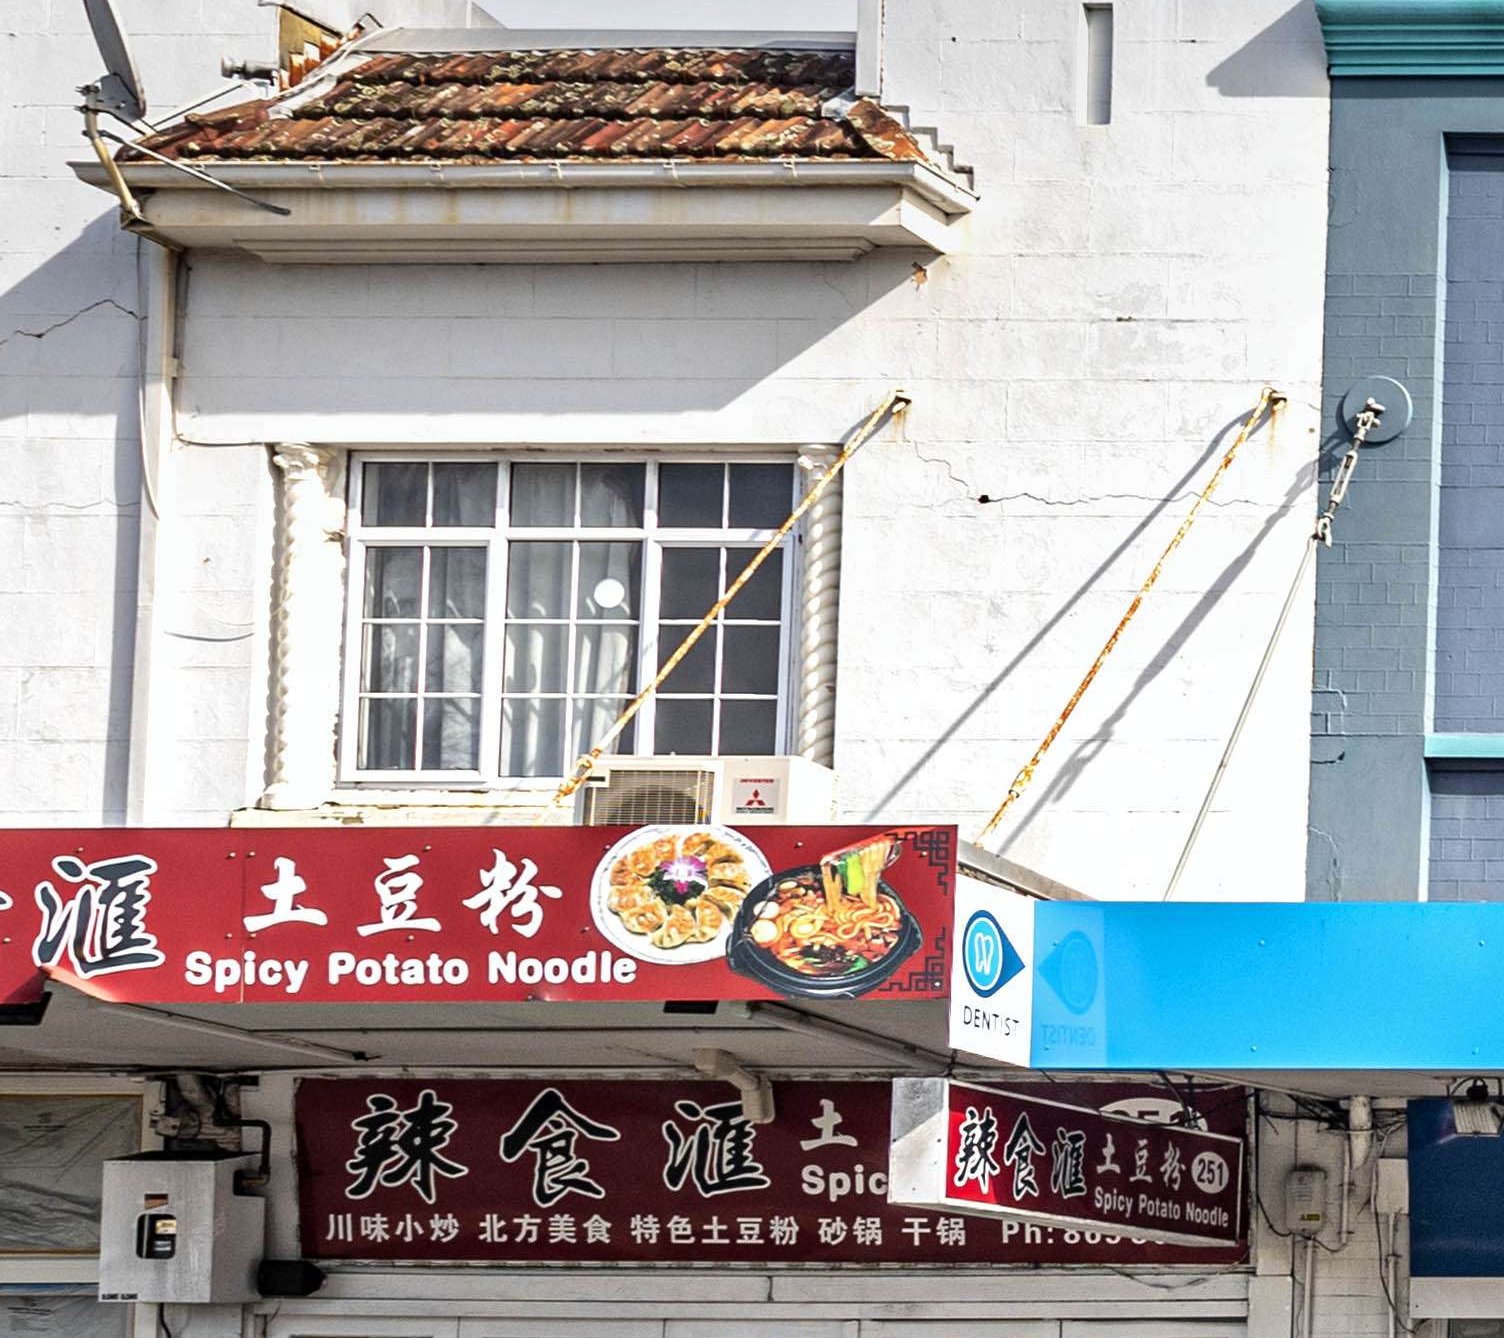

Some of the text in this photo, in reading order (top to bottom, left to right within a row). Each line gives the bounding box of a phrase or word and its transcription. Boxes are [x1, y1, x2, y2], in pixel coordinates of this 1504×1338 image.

[243, 848, 562, 938] 土豆粉
[185, 950, 637, 993] Spicy Potato Noodle
[801, 1163, 889, 1203] Spic
[1096, 1133, 1187, 1192] 土豆粉
[1196, 1158, 1224, 1187] 251
[1094, 1185, 1229, 1228] Spicy Potato Noodle
[326, 1213, 461, 1244] 川味小炒
[479, 1213, 612, 1244] 北方美食
[631, 1214, 800, 1246] 特色土豆粉
[818, 1214, 884, 1246] 砂锅
[901, 1215, 966, 1247] 干锅
